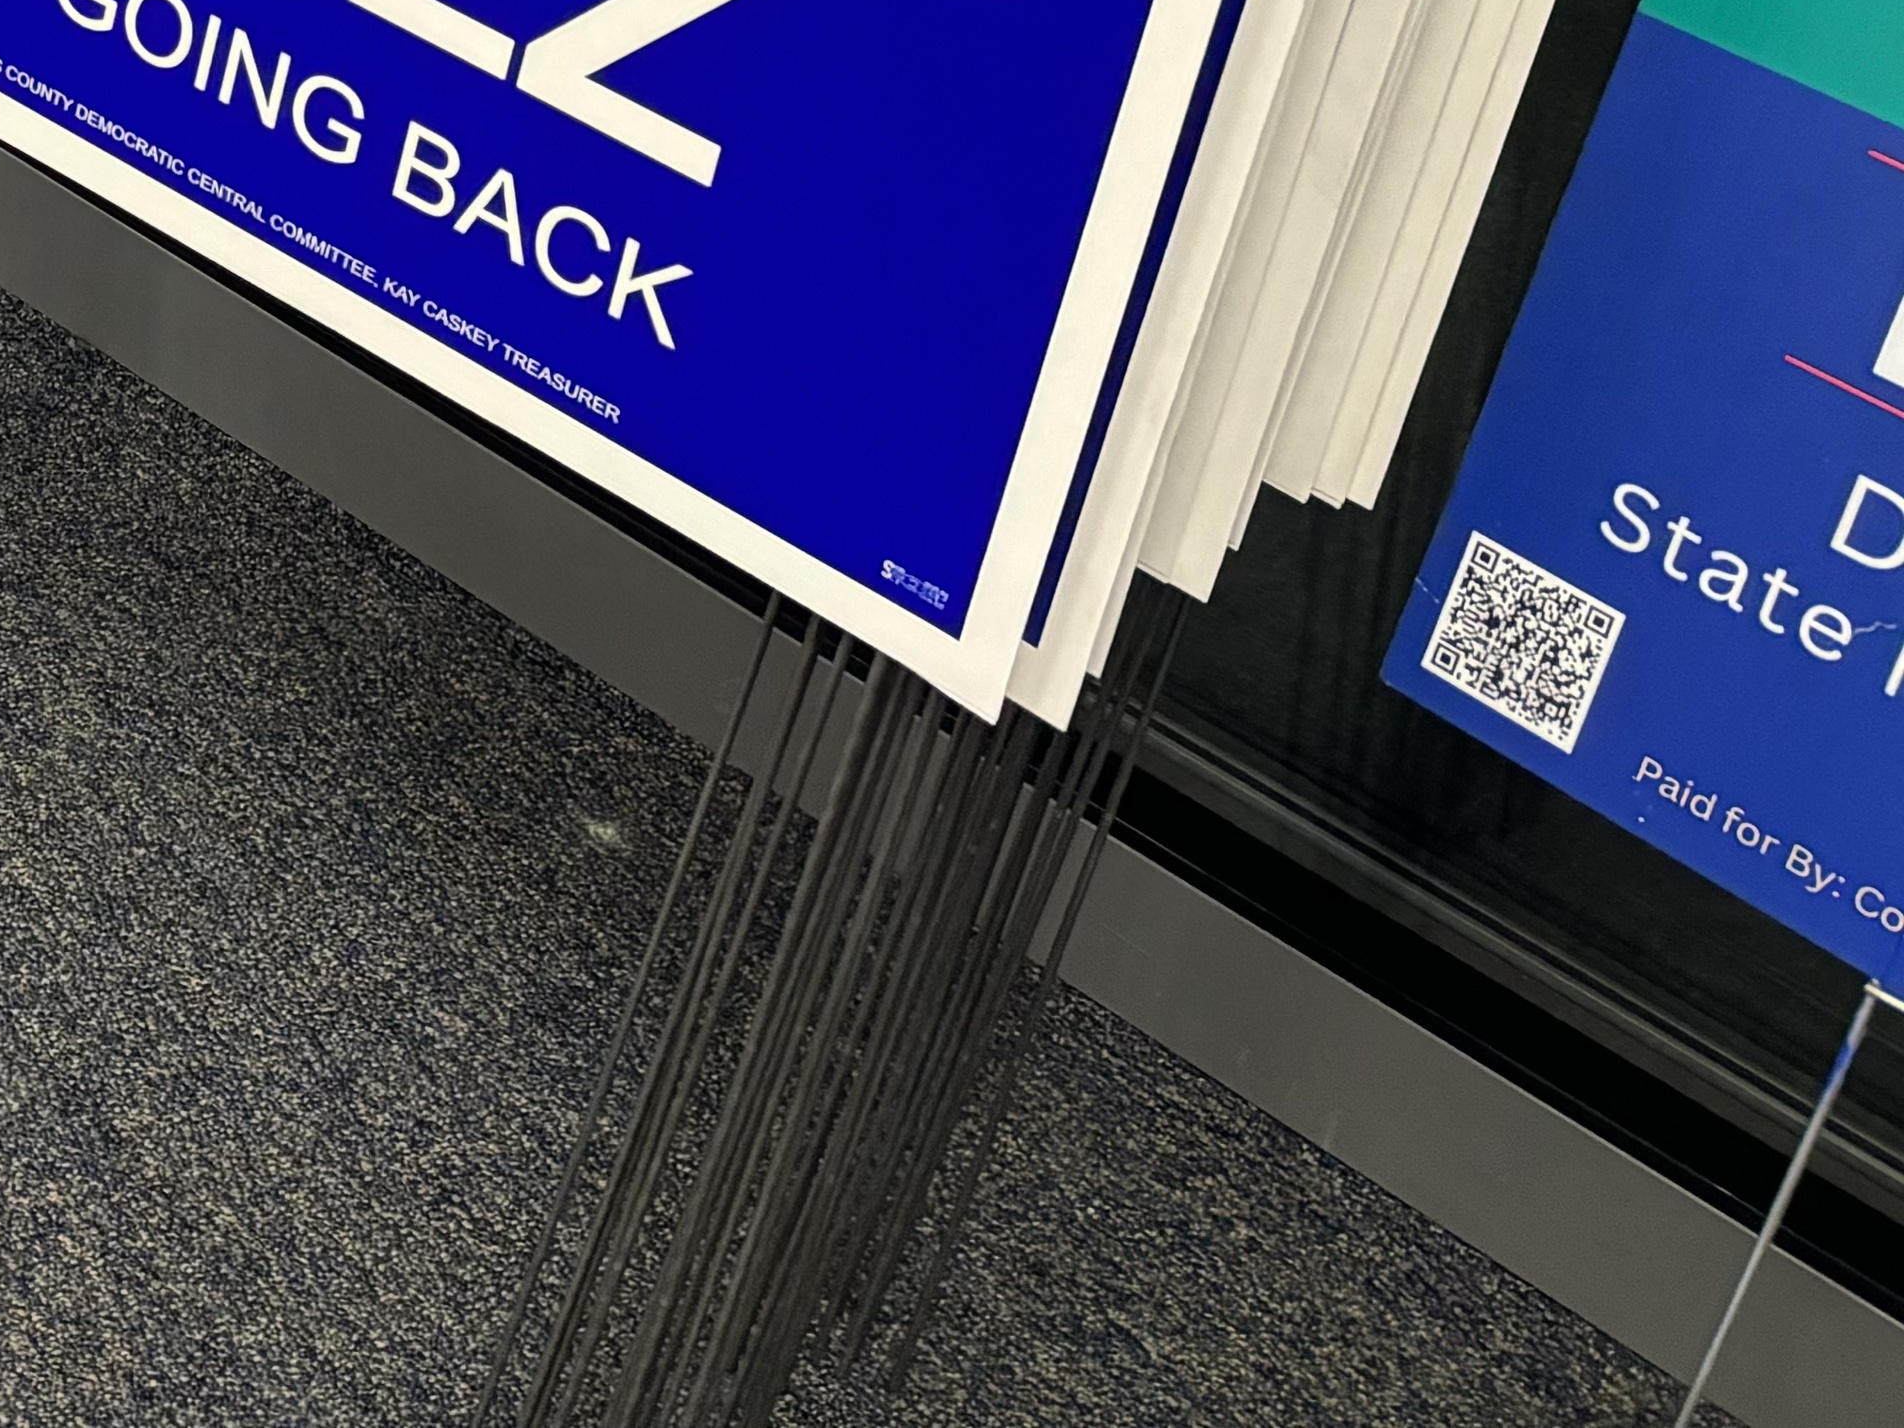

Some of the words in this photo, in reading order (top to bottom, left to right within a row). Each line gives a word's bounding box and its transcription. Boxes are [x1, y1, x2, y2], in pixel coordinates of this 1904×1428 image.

[5, 64, 73, 111] COUNTY
[75, 101, 184, 176] DEMOCRATIC
[187, 166, 267, 225] CENTRAL
[383, 277, 421, 307] KAY
[423, 300, 499, 353] CASKEY
[503, 343, 621, 425] TREASURER
[392, 120, 694, 350] BACK
[1600, 482, 1854, 661] State
[1633, 756, 1718, 822] Paid
[1723, 807, 1780, 856] for
[1784, 844, 1846, 899] By:
